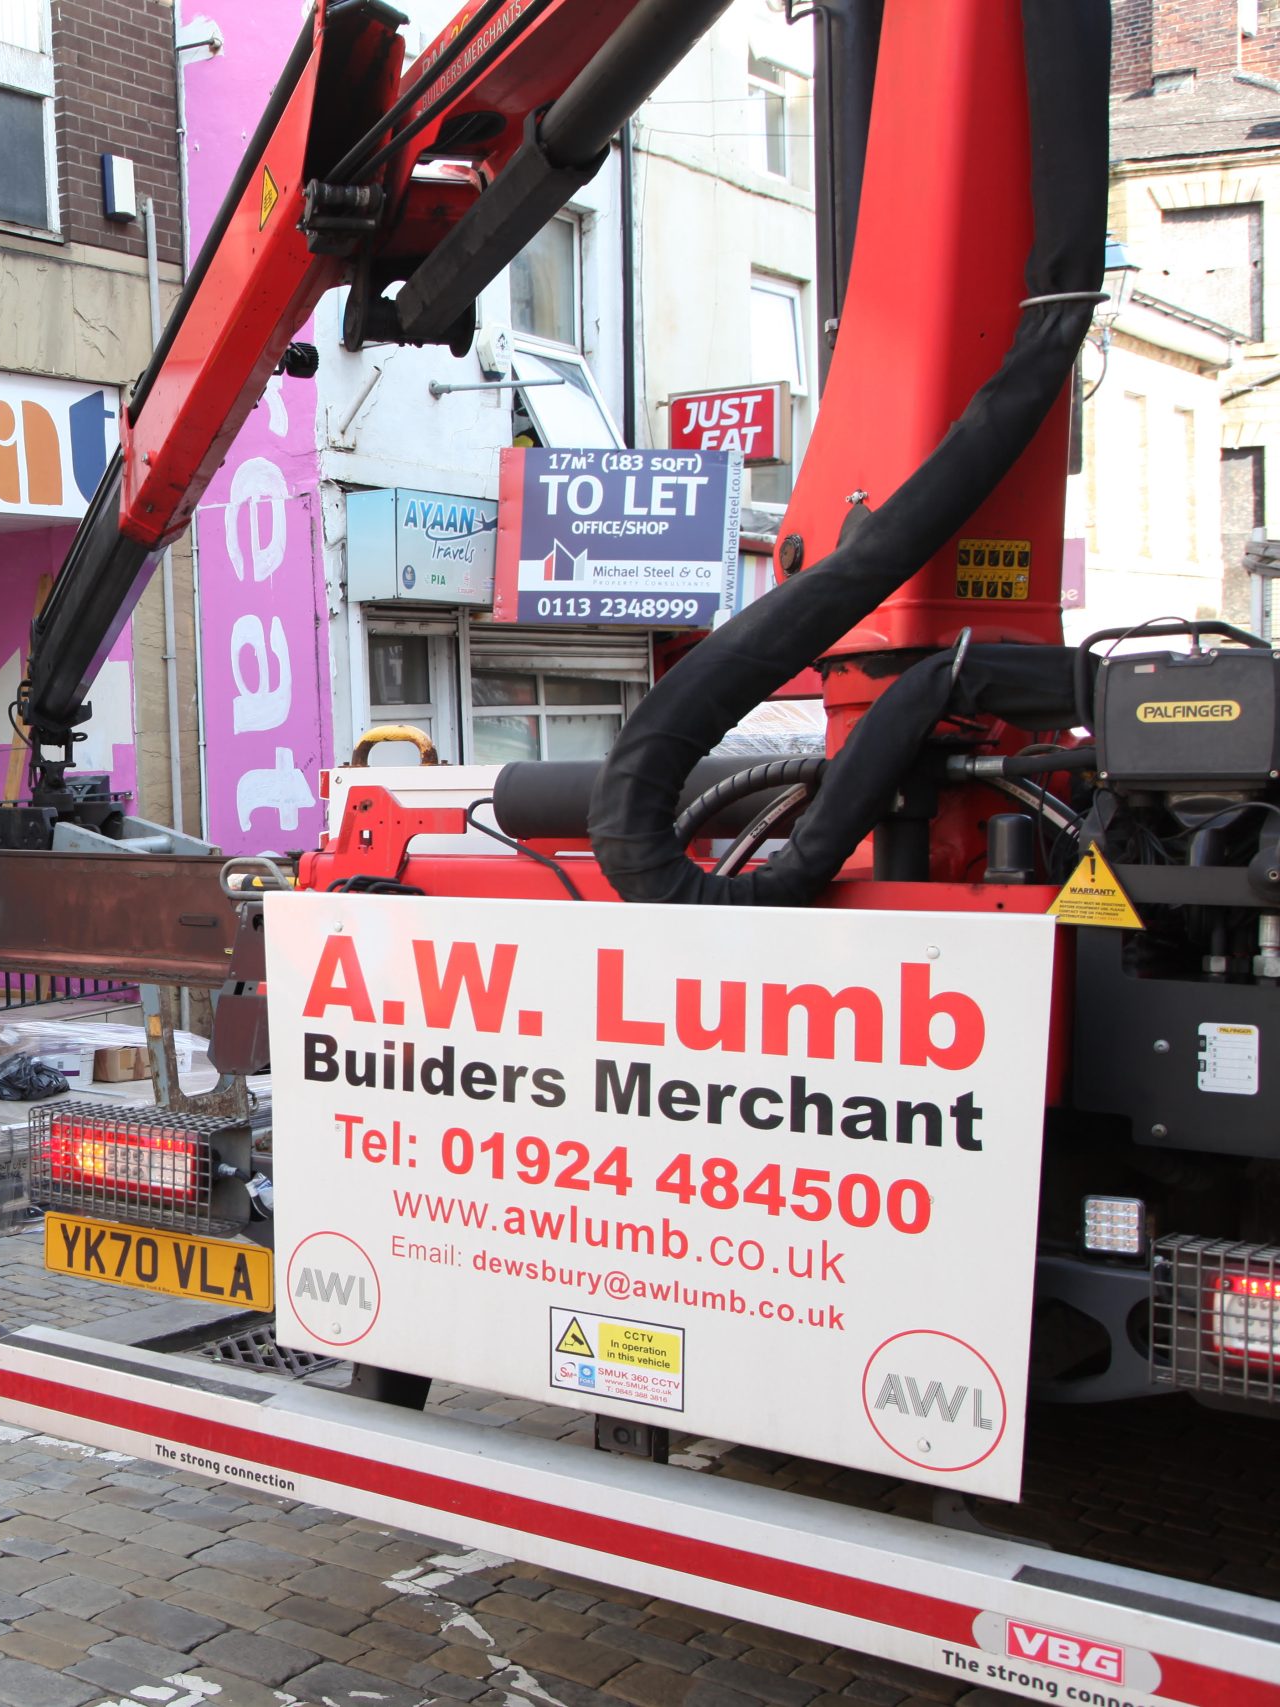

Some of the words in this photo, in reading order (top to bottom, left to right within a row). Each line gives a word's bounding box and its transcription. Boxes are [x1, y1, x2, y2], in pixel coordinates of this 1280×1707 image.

[421, 60, 466, 111] BUILDERS
[464, 0, 522, 68] MERCHANTS
[682, 395, 762, 435] JUST
[700, 426, 762, 454] EAT
[601, 453, 643, 473] (183
[651, 453, 702, 473] SQFT)
[539, 475, 604, 516] TO
[624, 475, 709, 516] LET
[404, 500, 476, 533] AYAAN
[572, 520, 669, 536] OFFICE/SHOP
[431, 540, 475, 563] Travels
[431, 574, 446, 585] PIA
[593, 566, 639, 578] Michael
[644, 566, 674, 578] Steel
[679, 567, 692, 578] &
[696, 567, 711, 579] Co
[538, 597, 590, 617] 0113
[600, 598, 698, 619] 2348999
[1143, 704, 1232, 718] PALFINGER
[1069, 887, 1116, 896] WARRANTY
[302, 934, 542, 1037] A.W.
[596, 948, 986, 1071] Lumb
[304, 1032, 566, 1108] Builders
[595, 1058, 983, 1152] Merchant
[334, 1113, 417, 1168] Tel:
[441, 1127, 633, 1196] 01924
[655, 1153, 932, 1235] 484500
[393, 1190, 846, 1284] www.awlumb.co.uk
[60, 1223, 158, 1282] YK70
[173, 1242, 253, 1301] VLA
[295, 1267, 372, 1311] AWL
[392, 1235, 461, 1267] Email:
[472, 1250, 845, 1330] dewsbury@awlumb.co.uk
[611, 1339, 619, 1348] In
[622, 1343, 667, 1357] operation
[624, 1331, 654, 1343] CCTV
[607, 1350, 615, 1358] in
[618, 1352, 635, 1363] this
[637, 1356, 671, 1369] vehicle
[598, 1367, 628, 1380] SMUK
[631, 1373, 648, 1383] 360
[652, 1377, 680, 1389] CCTV
[604, 1379, 672, 1395] www.SMUK.co.uk
[874, 1373, 993, 1431] AWL
[155, 1444, 176, 1459] The
[180, 1452, 220, 1474] strong
[224, 1463, 295, 1491] connection
[1012, 1626, 1119, 1678] VBG
[942, 1649, 979, 1672] The
[986, 1664, 1058, 1698] strong
